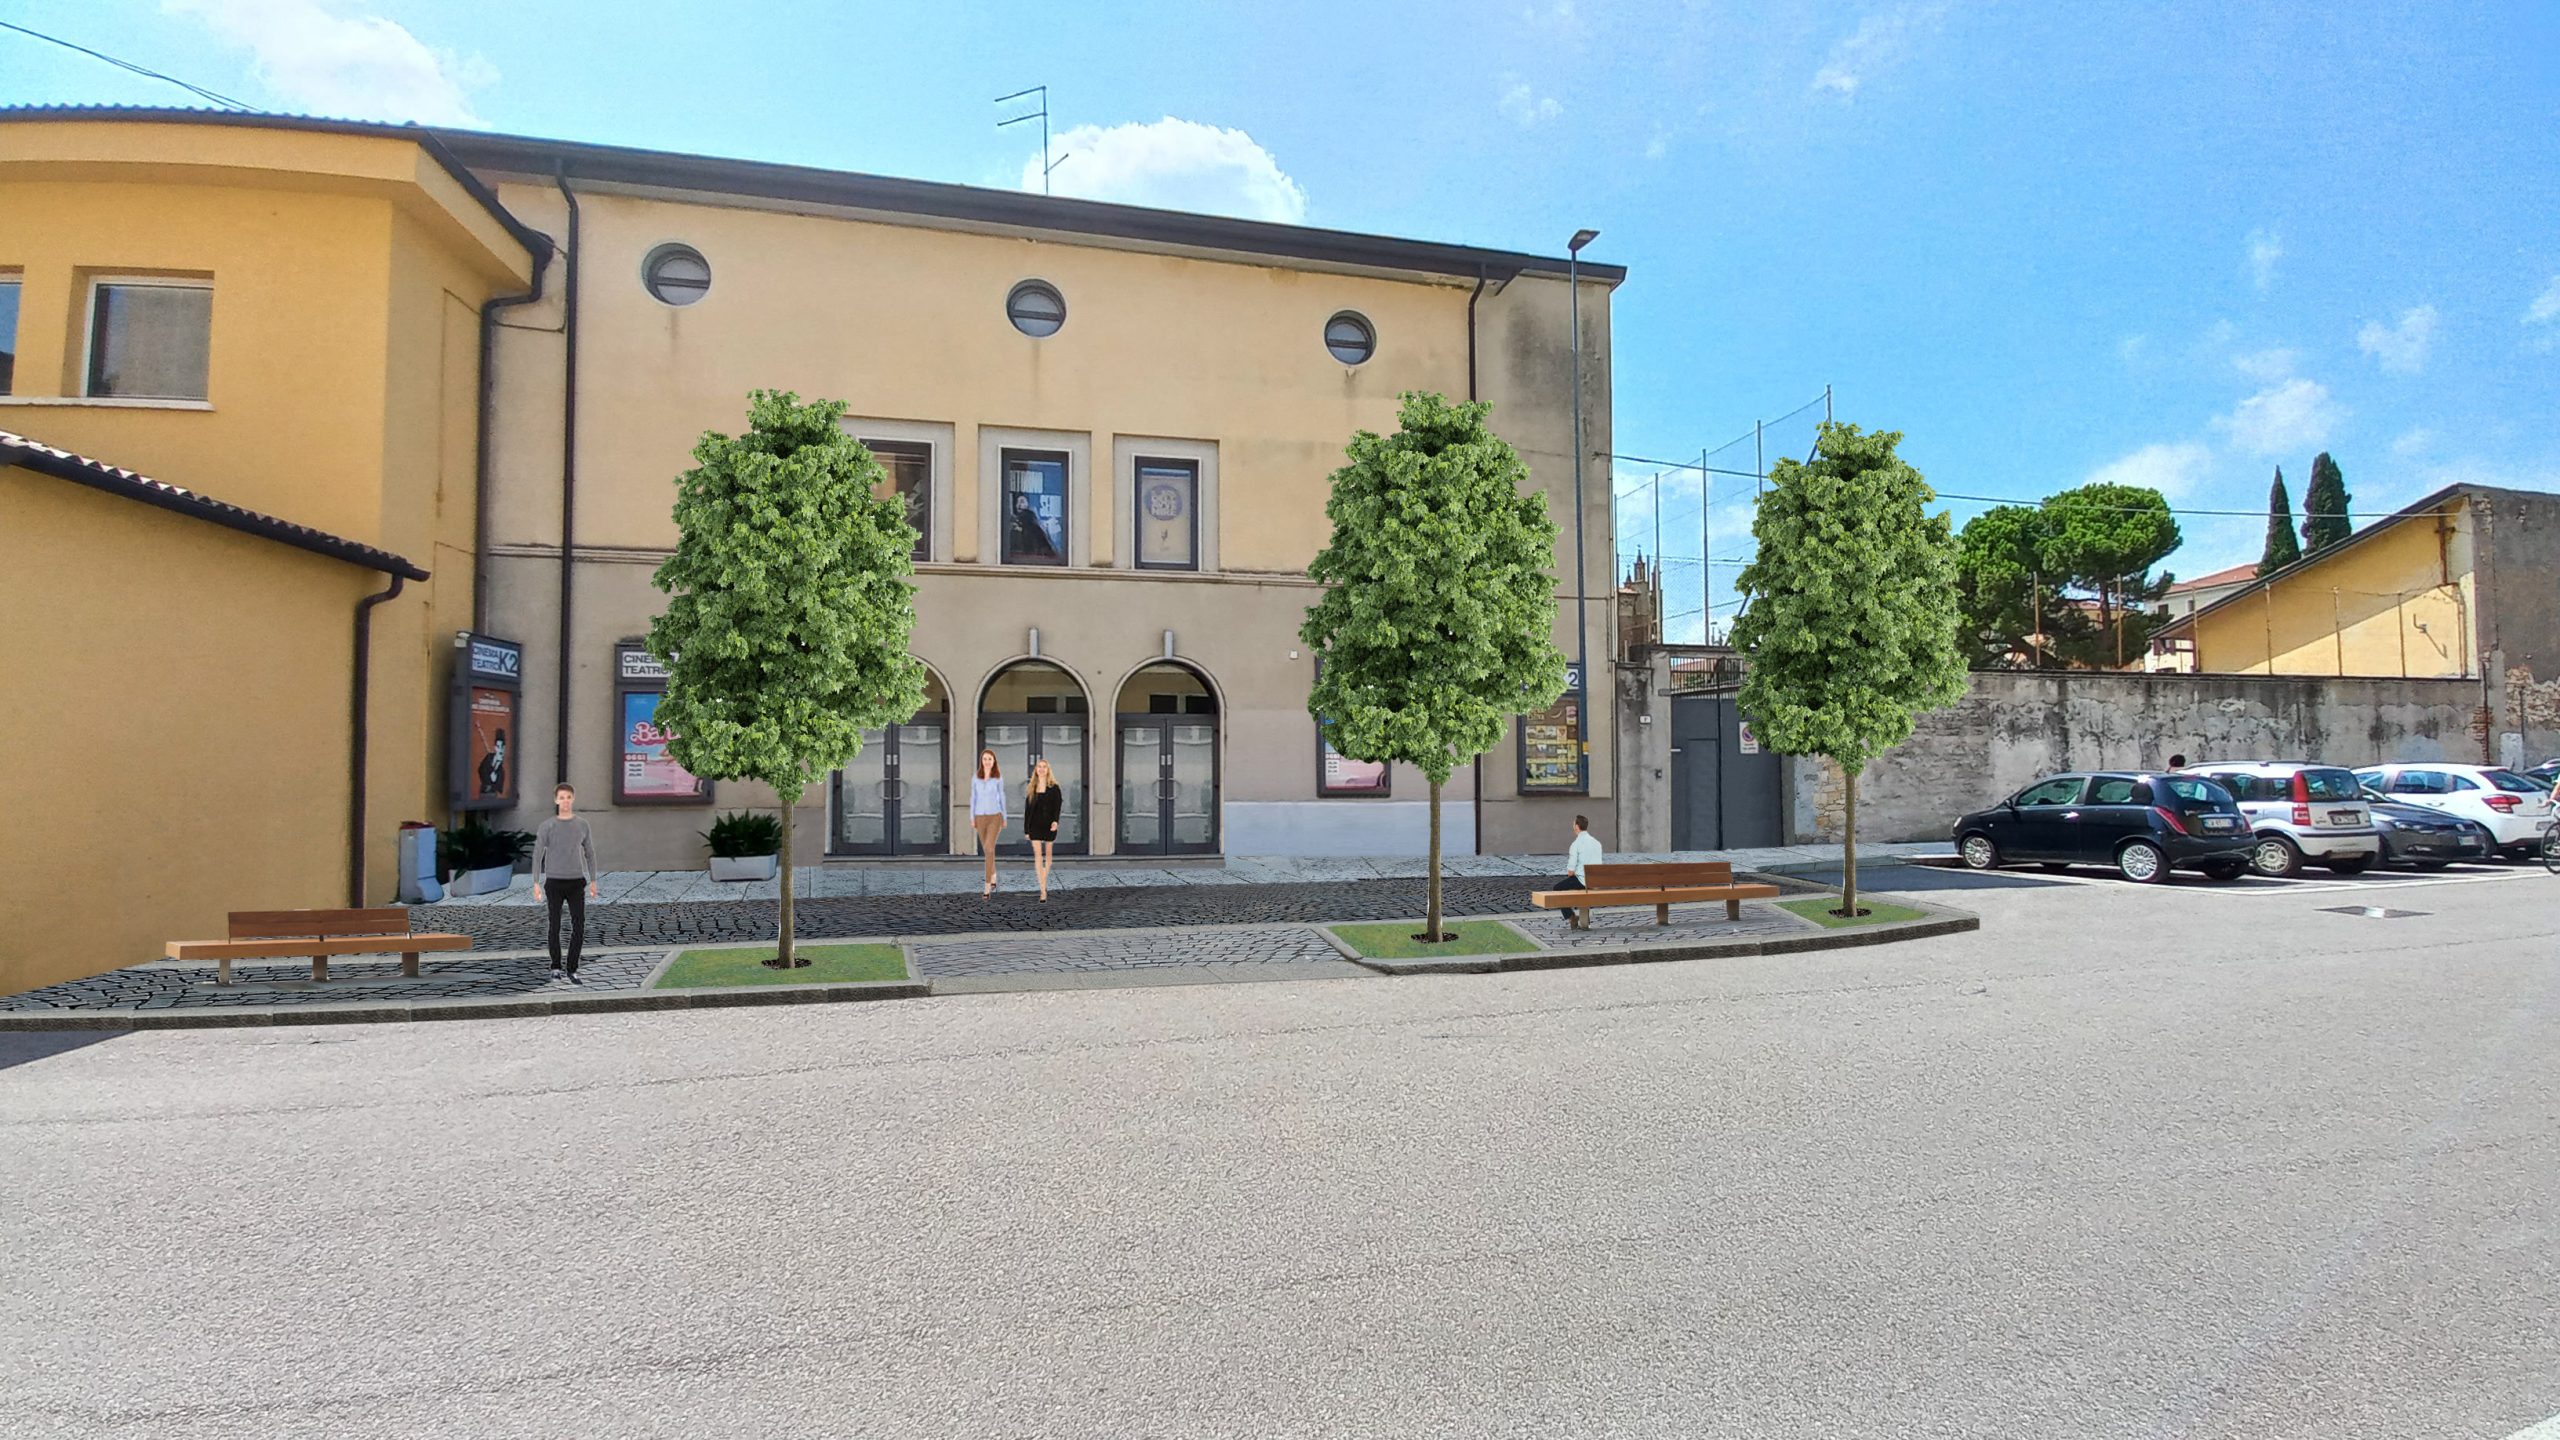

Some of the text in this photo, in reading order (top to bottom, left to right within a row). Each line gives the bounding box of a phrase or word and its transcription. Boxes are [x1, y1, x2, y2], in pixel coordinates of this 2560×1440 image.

[472, 645, 499, 658] CINEMA
[472, 657, 500, 671] TEATRO
[499, 650, 519, 673] K2
[623, 654, 662, 664] CINE
